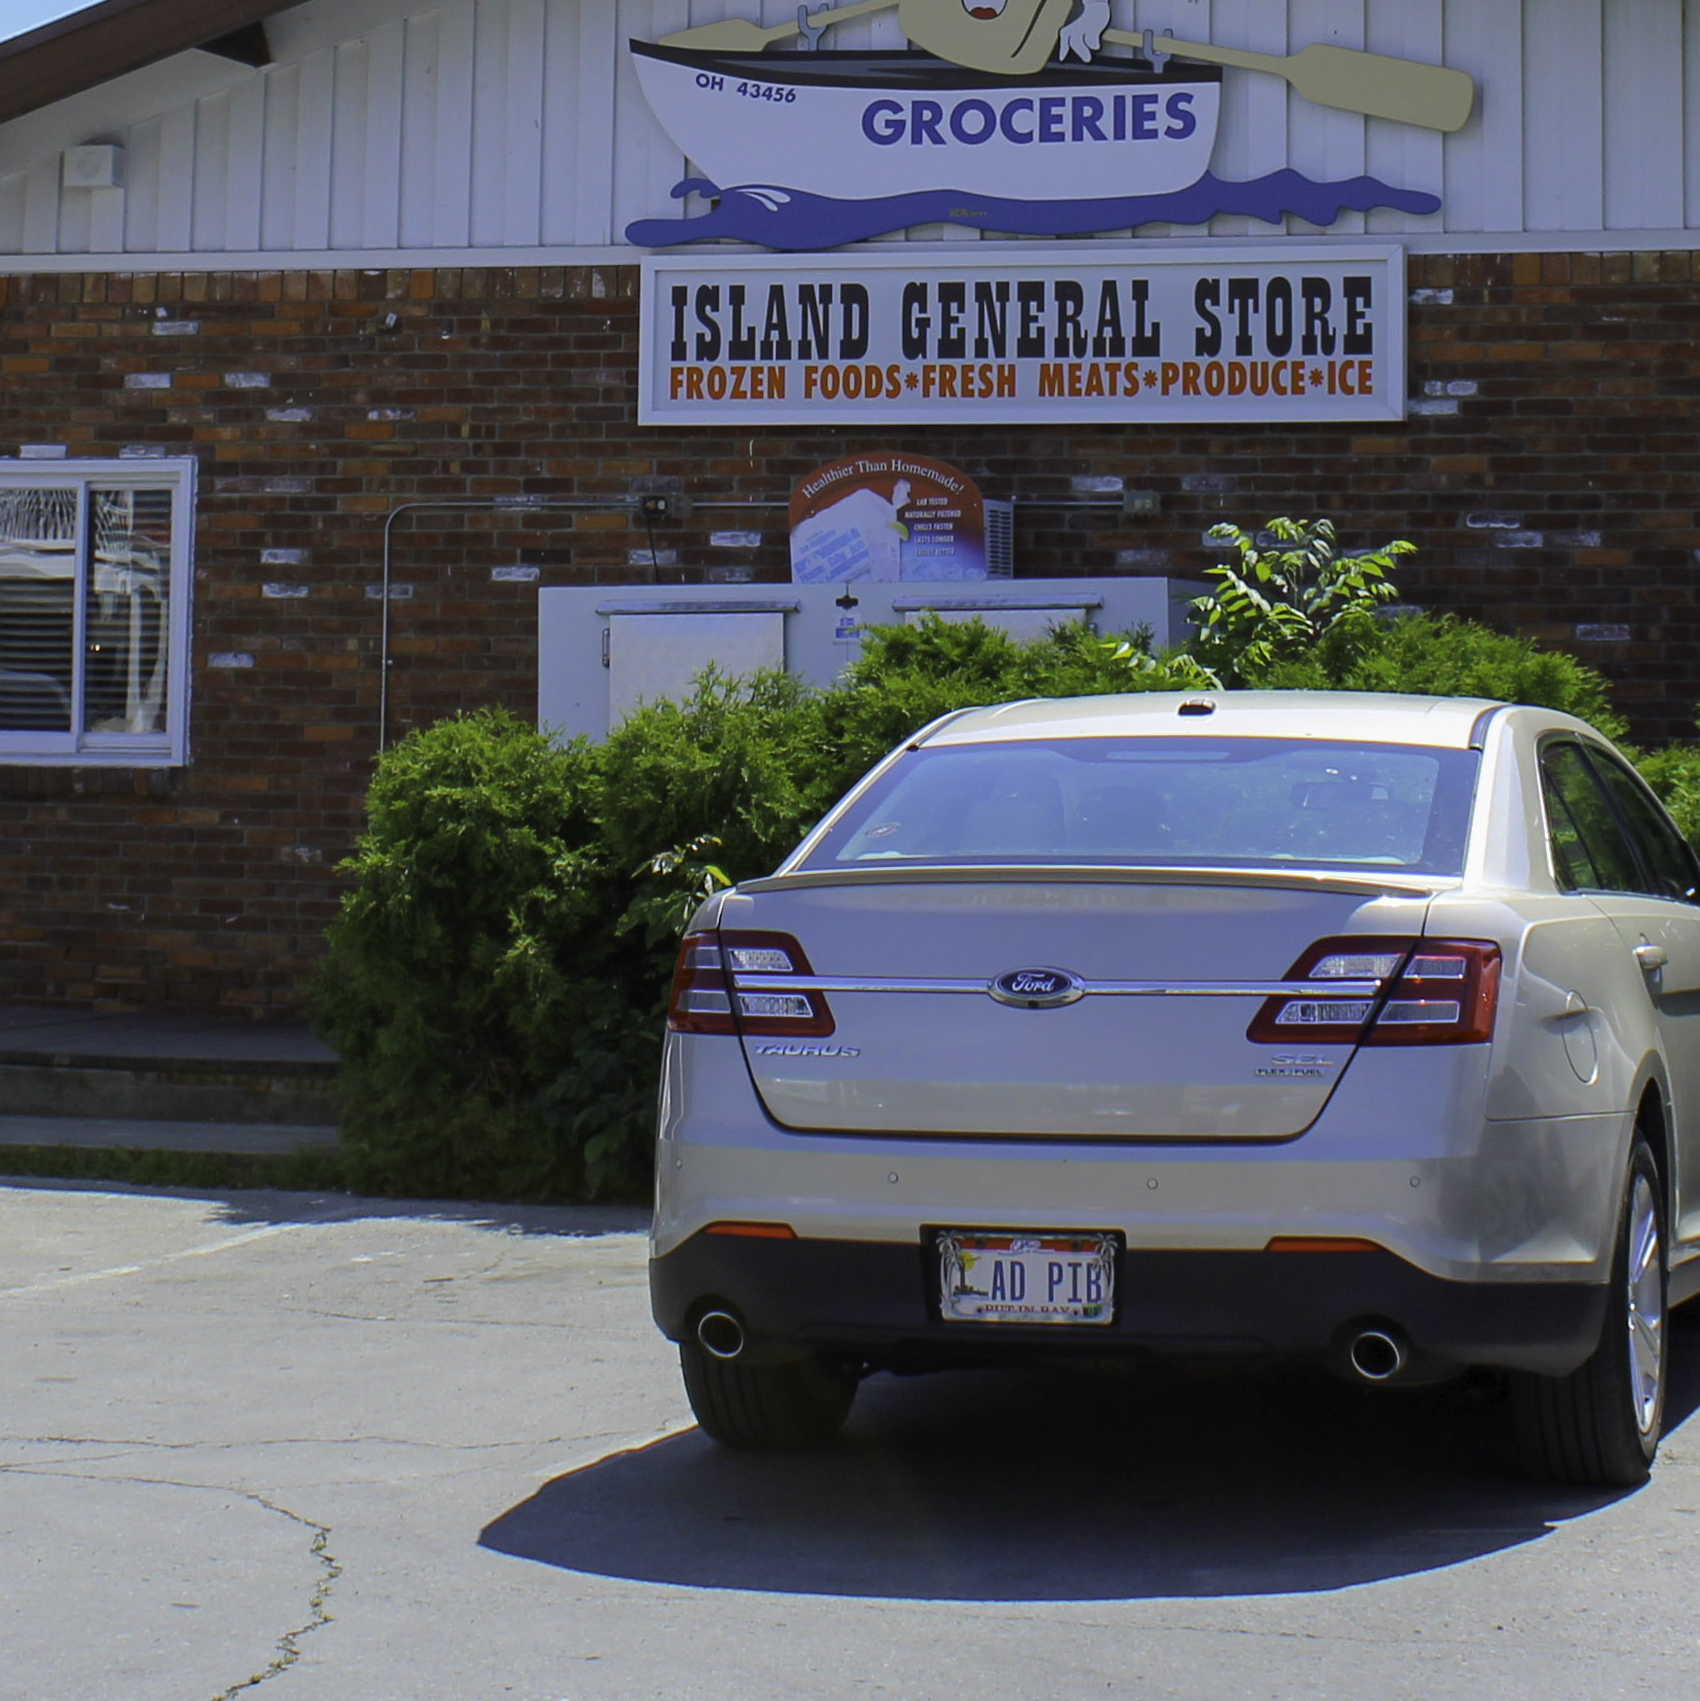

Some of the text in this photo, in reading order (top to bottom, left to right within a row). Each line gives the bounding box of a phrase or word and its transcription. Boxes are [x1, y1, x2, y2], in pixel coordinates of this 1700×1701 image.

[696, 73, 796, 103] OH 43456
[862, 92, 1196, 145] GROCERIES
[671, 276, 1373, 361] ISLAND GENERAL STORE
[670, 366, 785, 400] FROZEN
[801, 459, 964, 498] Healthier Than Homemade!
[1012, 972, 1056, 992] Ford
[756, 1044, 861, 1057] TAURUS
[1271, 1053, 1335, 1066] SEL
[991, 1260, 1102, 1303] AD PIB
